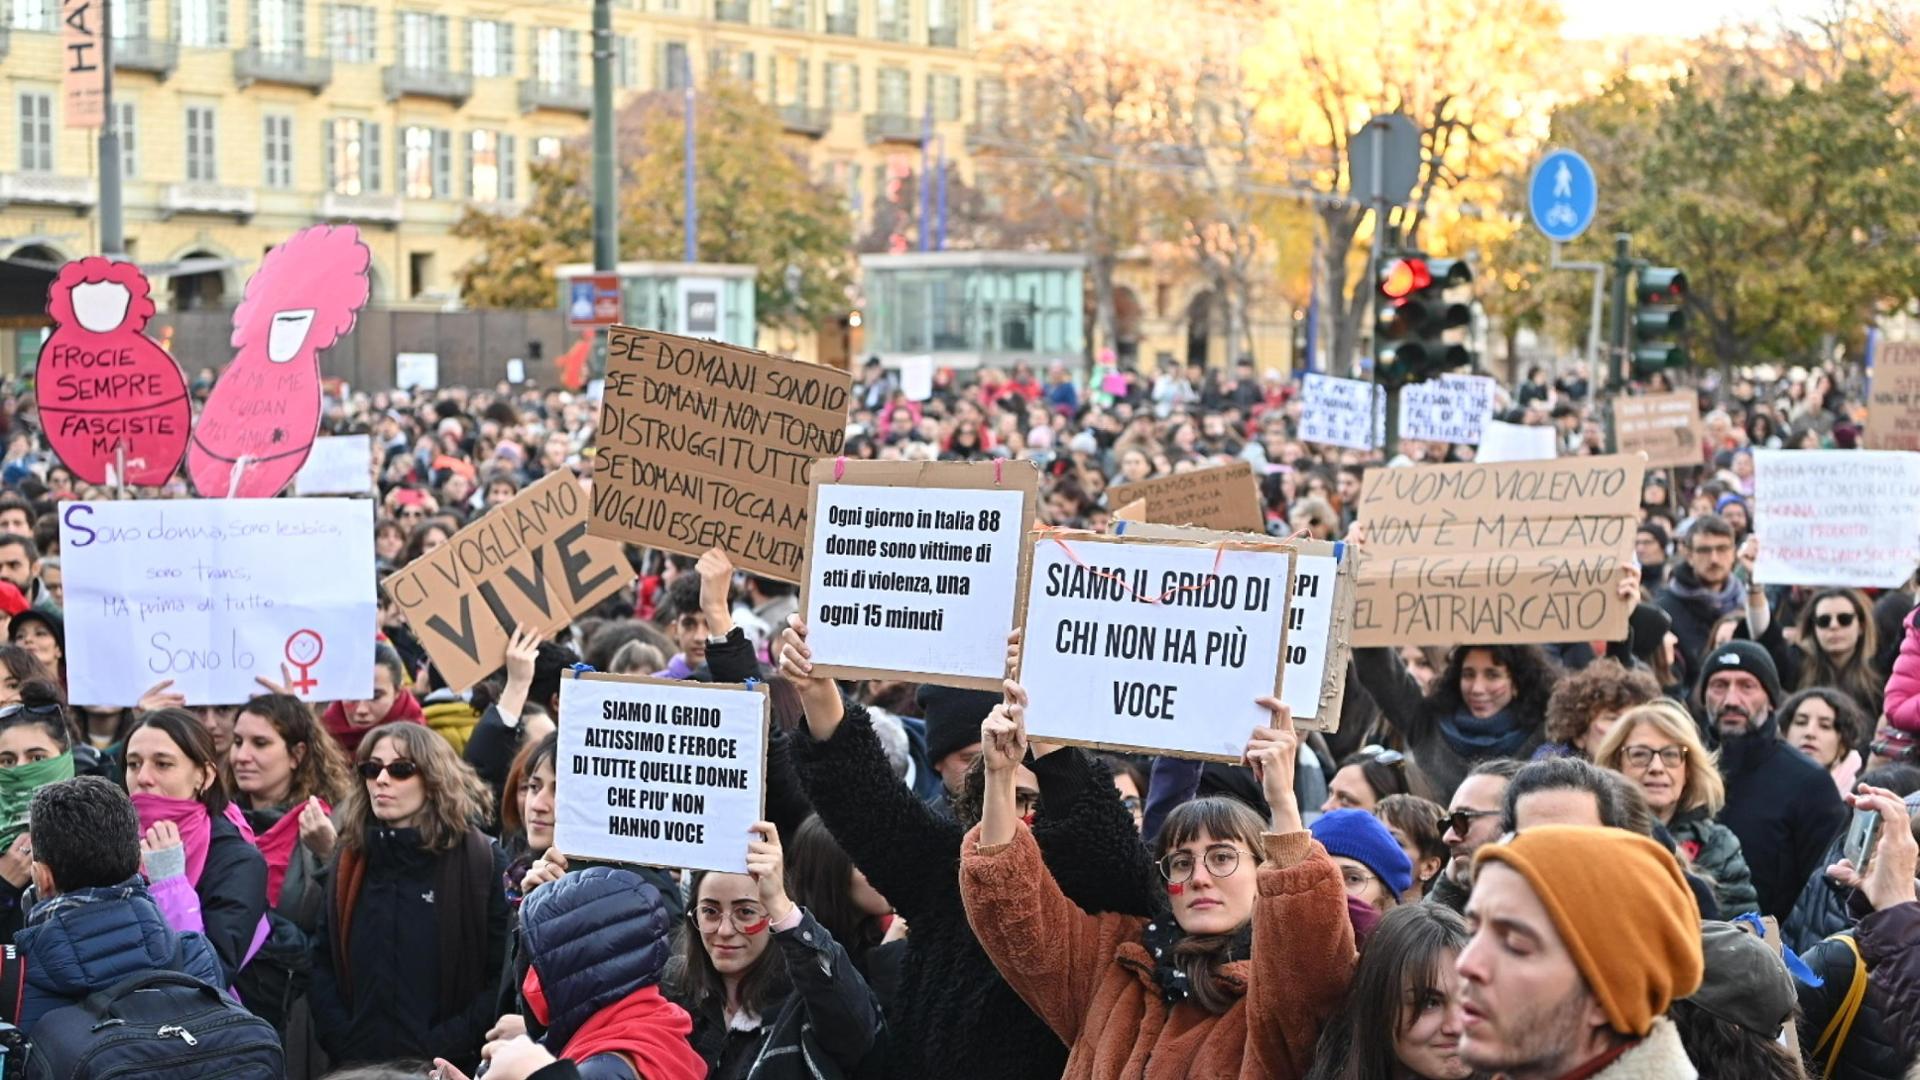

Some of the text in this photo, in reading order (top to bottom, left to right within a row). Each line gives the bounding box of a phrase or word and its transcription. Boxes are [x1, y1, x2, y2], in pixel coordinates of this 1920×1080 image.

[65, 0, 97, 72] HA
[52, 344, 136, 369] FROCIE
[610, 335, 847, 411] SE DOMANI SONO IO
[56, 373, 163, 402] SEMPRE
[60, 414, 174, 437] FASCISTE
[604, 371, 844, 455] SE DOMANI NON TORNO
[92, 435, 134, 457] MAI
[601, 403, 725, 466] DISTRUGGI
[595, 447, 628, 480] SE
[632, 457, 702, 504] DOMANI
[707, 481, 775, 523] TOCCA
[1364, 468, 1626, 505] L'UOMO VIOLENTO
[592, 483, 666, 531] VOGLIO
[667, 511, 742, 554] ESSERE
[829, 505, 1001, 532] Ogni giorno in Italia 88
[1365, 508, 1625, 548] NON È MALATO
[394, 481, 577, 608] CI VOGLIAMO
[826, 534, 992, 563] donne sono vittime di
[823, 569, 970, 595] atti di violenza, una
[1046, 562, 1271, 612] SIAMO IL GRIDO DI
[1389, 555, 1519, 589] FIGLIO
[1531, 555, 1617, 588] SANO
[197, 597, 215, 612] di
[226, 592, 274, 612] tutto
[425, 520, 618, 665] VIVE
[820, 602, 944, 631] ogni 15 minuti
[1393, 589, 1607, 635] PATRIARCATO
[1055, 619, 1248, 669] CHI NON HA PIÙ
[602, 700, 721, 728] SIAMO IL GRIDO
[1113, 681, 1178, 721] VOCE
[584, 728, 737, 759] ALTISSIMO E FEROCE
[573, 755, 748, 790] DI TUTTE QUELLE DONNE
[607, 787, 705, 815] CHE PIU' NON
[609, 816, 704, 844] HANNO VOCE
